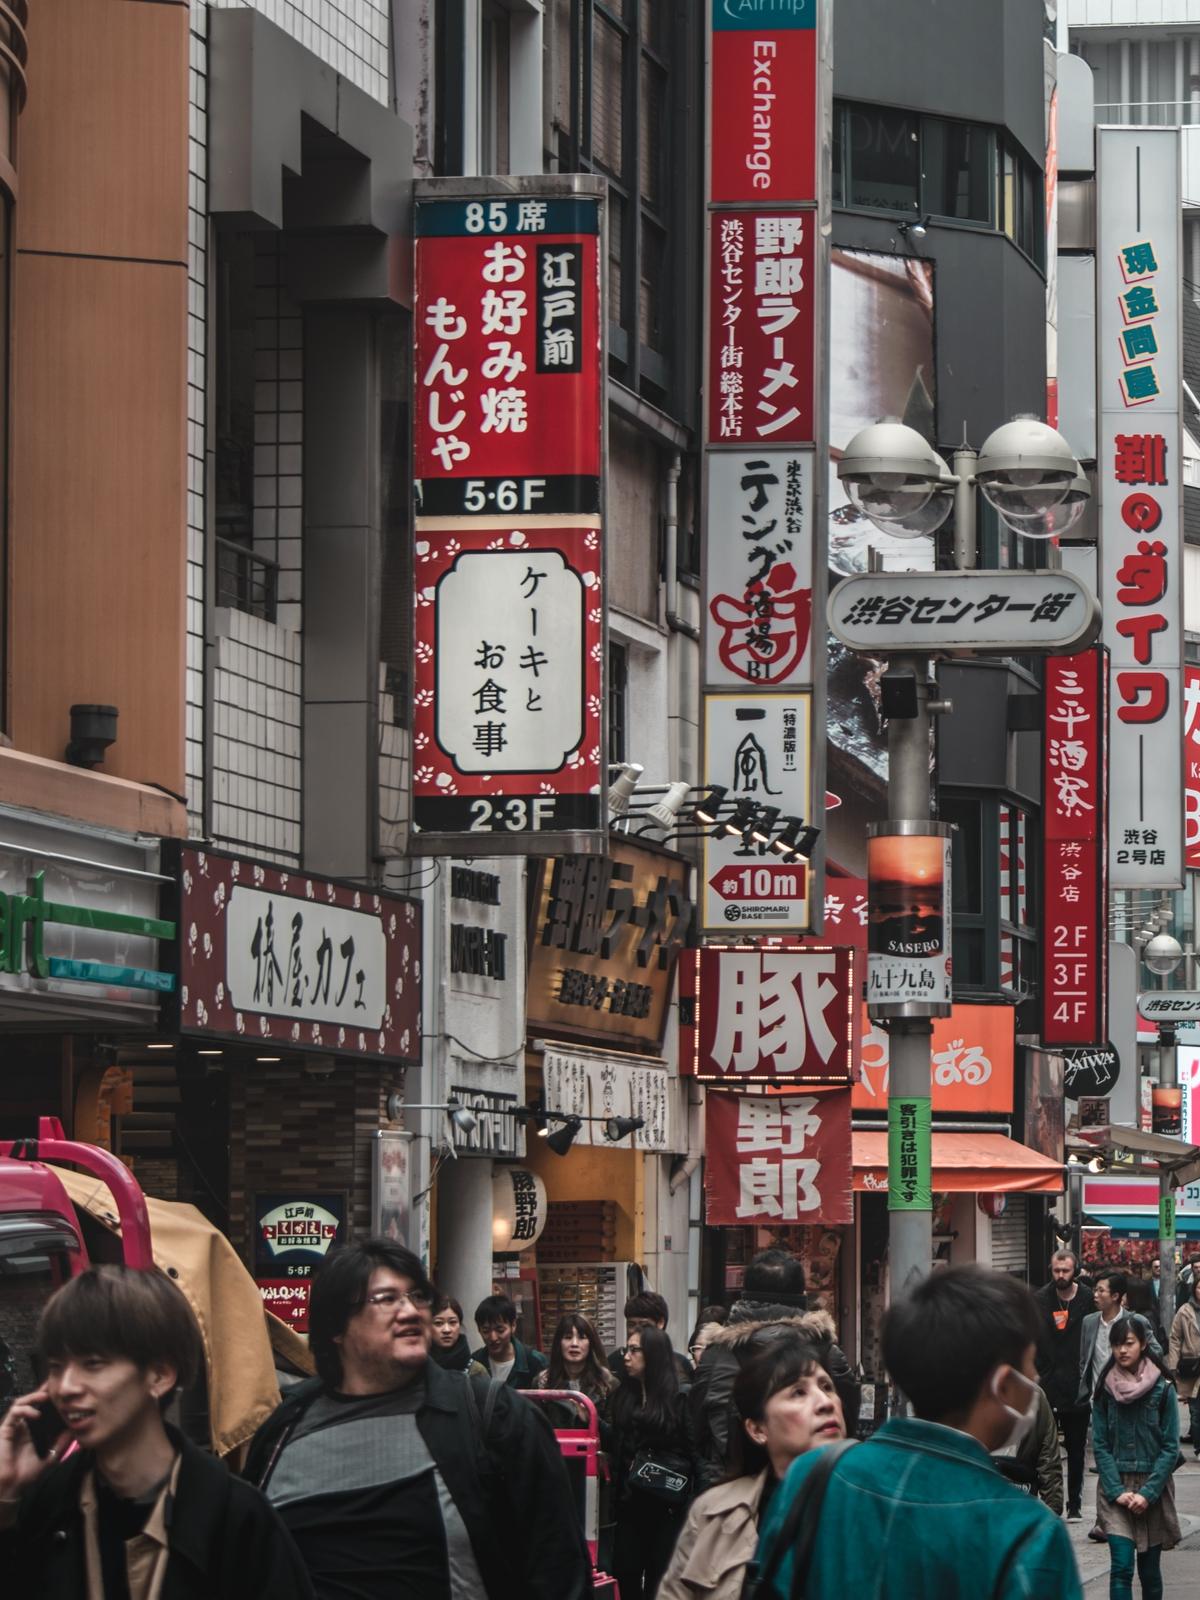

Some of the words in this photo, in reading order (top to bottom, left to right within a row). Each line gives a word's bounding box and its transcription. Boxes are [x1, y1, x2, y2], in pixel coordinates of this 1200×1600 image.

[745, 41, 776, 189] Exchange
[465, 201, 547, 232] 85席
[542, 252, 576, 366] 江戸前
[720, 219, 743, 368] 渋谷センター街
[1121, 241, 1159, 400] 現金問屋
[480, 242, 528, 433] お好み焼
[755, 217, 803, 437] 野郎ラーメン
[424, 297, 470, 471] もんじゃ
[720, 372, 743, 437] 総本店
[519, 567, 548, 712] ケーキと
[842, 593, 1077, 625] 渋谷センター街
[472, 641, 508, 757] お食事
[745, 660, 771, 679] B1
[1117, 849, 1165, 866] 2号店
[1124, 829, 1158, 845] 渋谷
[1061, 843, 1082, 902] 渋谷店
[888, 938, 940, 953] SASEBO
[1054, 926, 1087, 947] 2F
[871, 970, 935, 991] 九十九島
[1054, 964, 1087, 985] 3F
[711, 952, 838, 1073] 豚
[1054, 1002, 1087, 1022] 4F
[857, 1028, 992, 1096] やばる
[737, 1097, 822, 1220] 野郎
[900, 1103, 918, 1203] 客引きは犯罪です
[265, 1222, 335, 1239] こてがえし
[284, 1206, 315, 1219] 江戸前
[511, 1171, 538, 1240] 豚野郎
[292, 1309, 305, 1317] 4F
